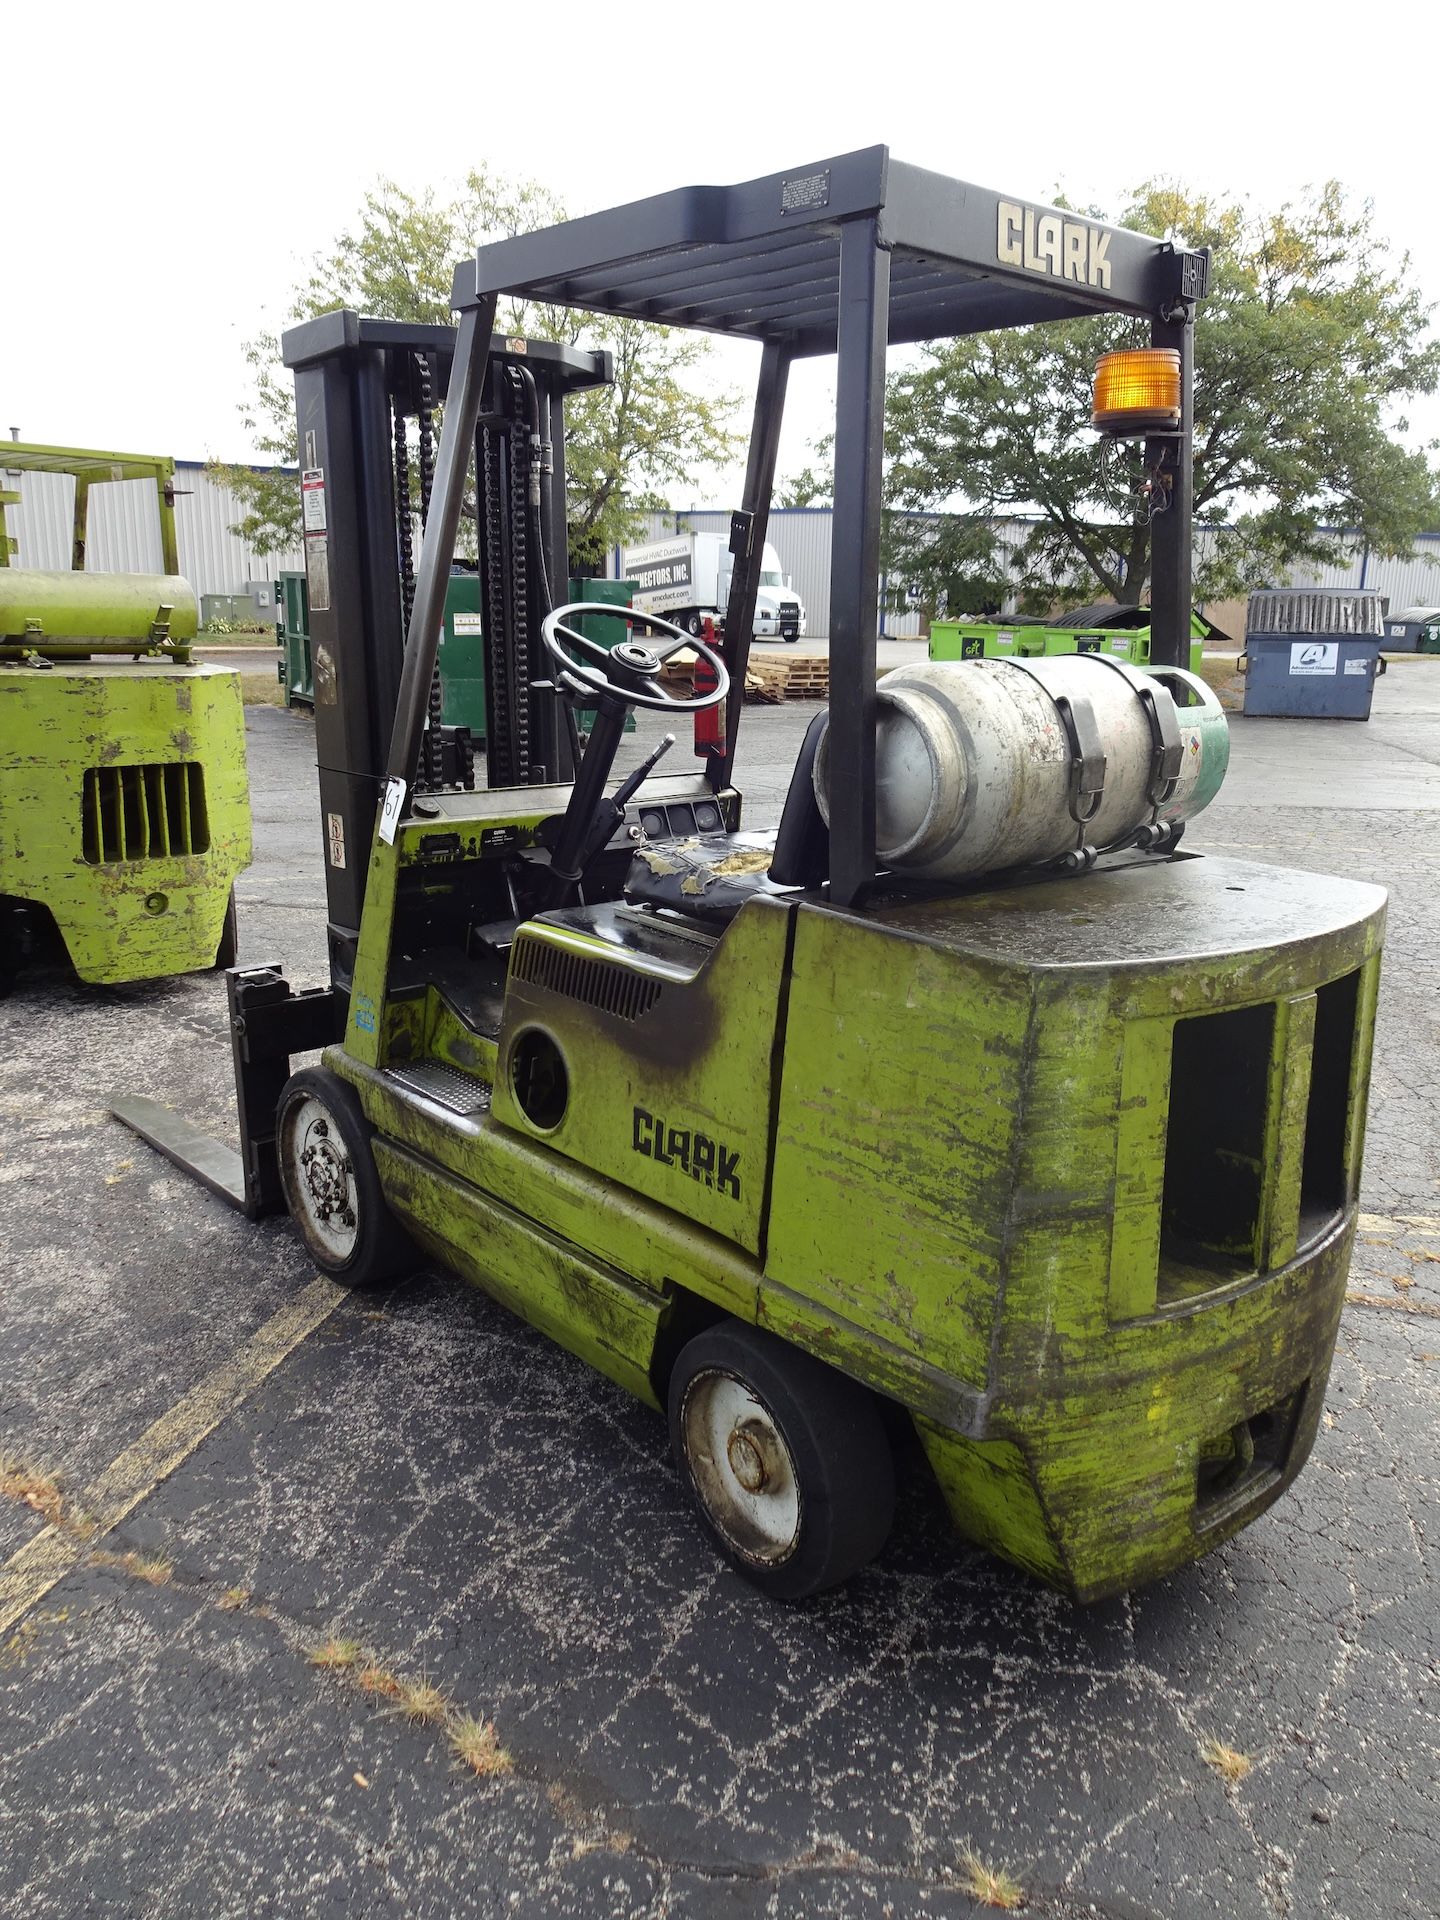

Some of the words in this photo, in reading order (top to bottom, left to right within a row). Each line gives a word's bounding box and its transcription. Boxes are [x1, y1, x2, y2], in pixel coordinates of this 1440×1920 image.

[997, 201, 1112, 290] CLARK
[673, 563, 688, 582] INC.
[385, 789, 400, 820] 61
[633, 1105, 740, 1201] CLARK
